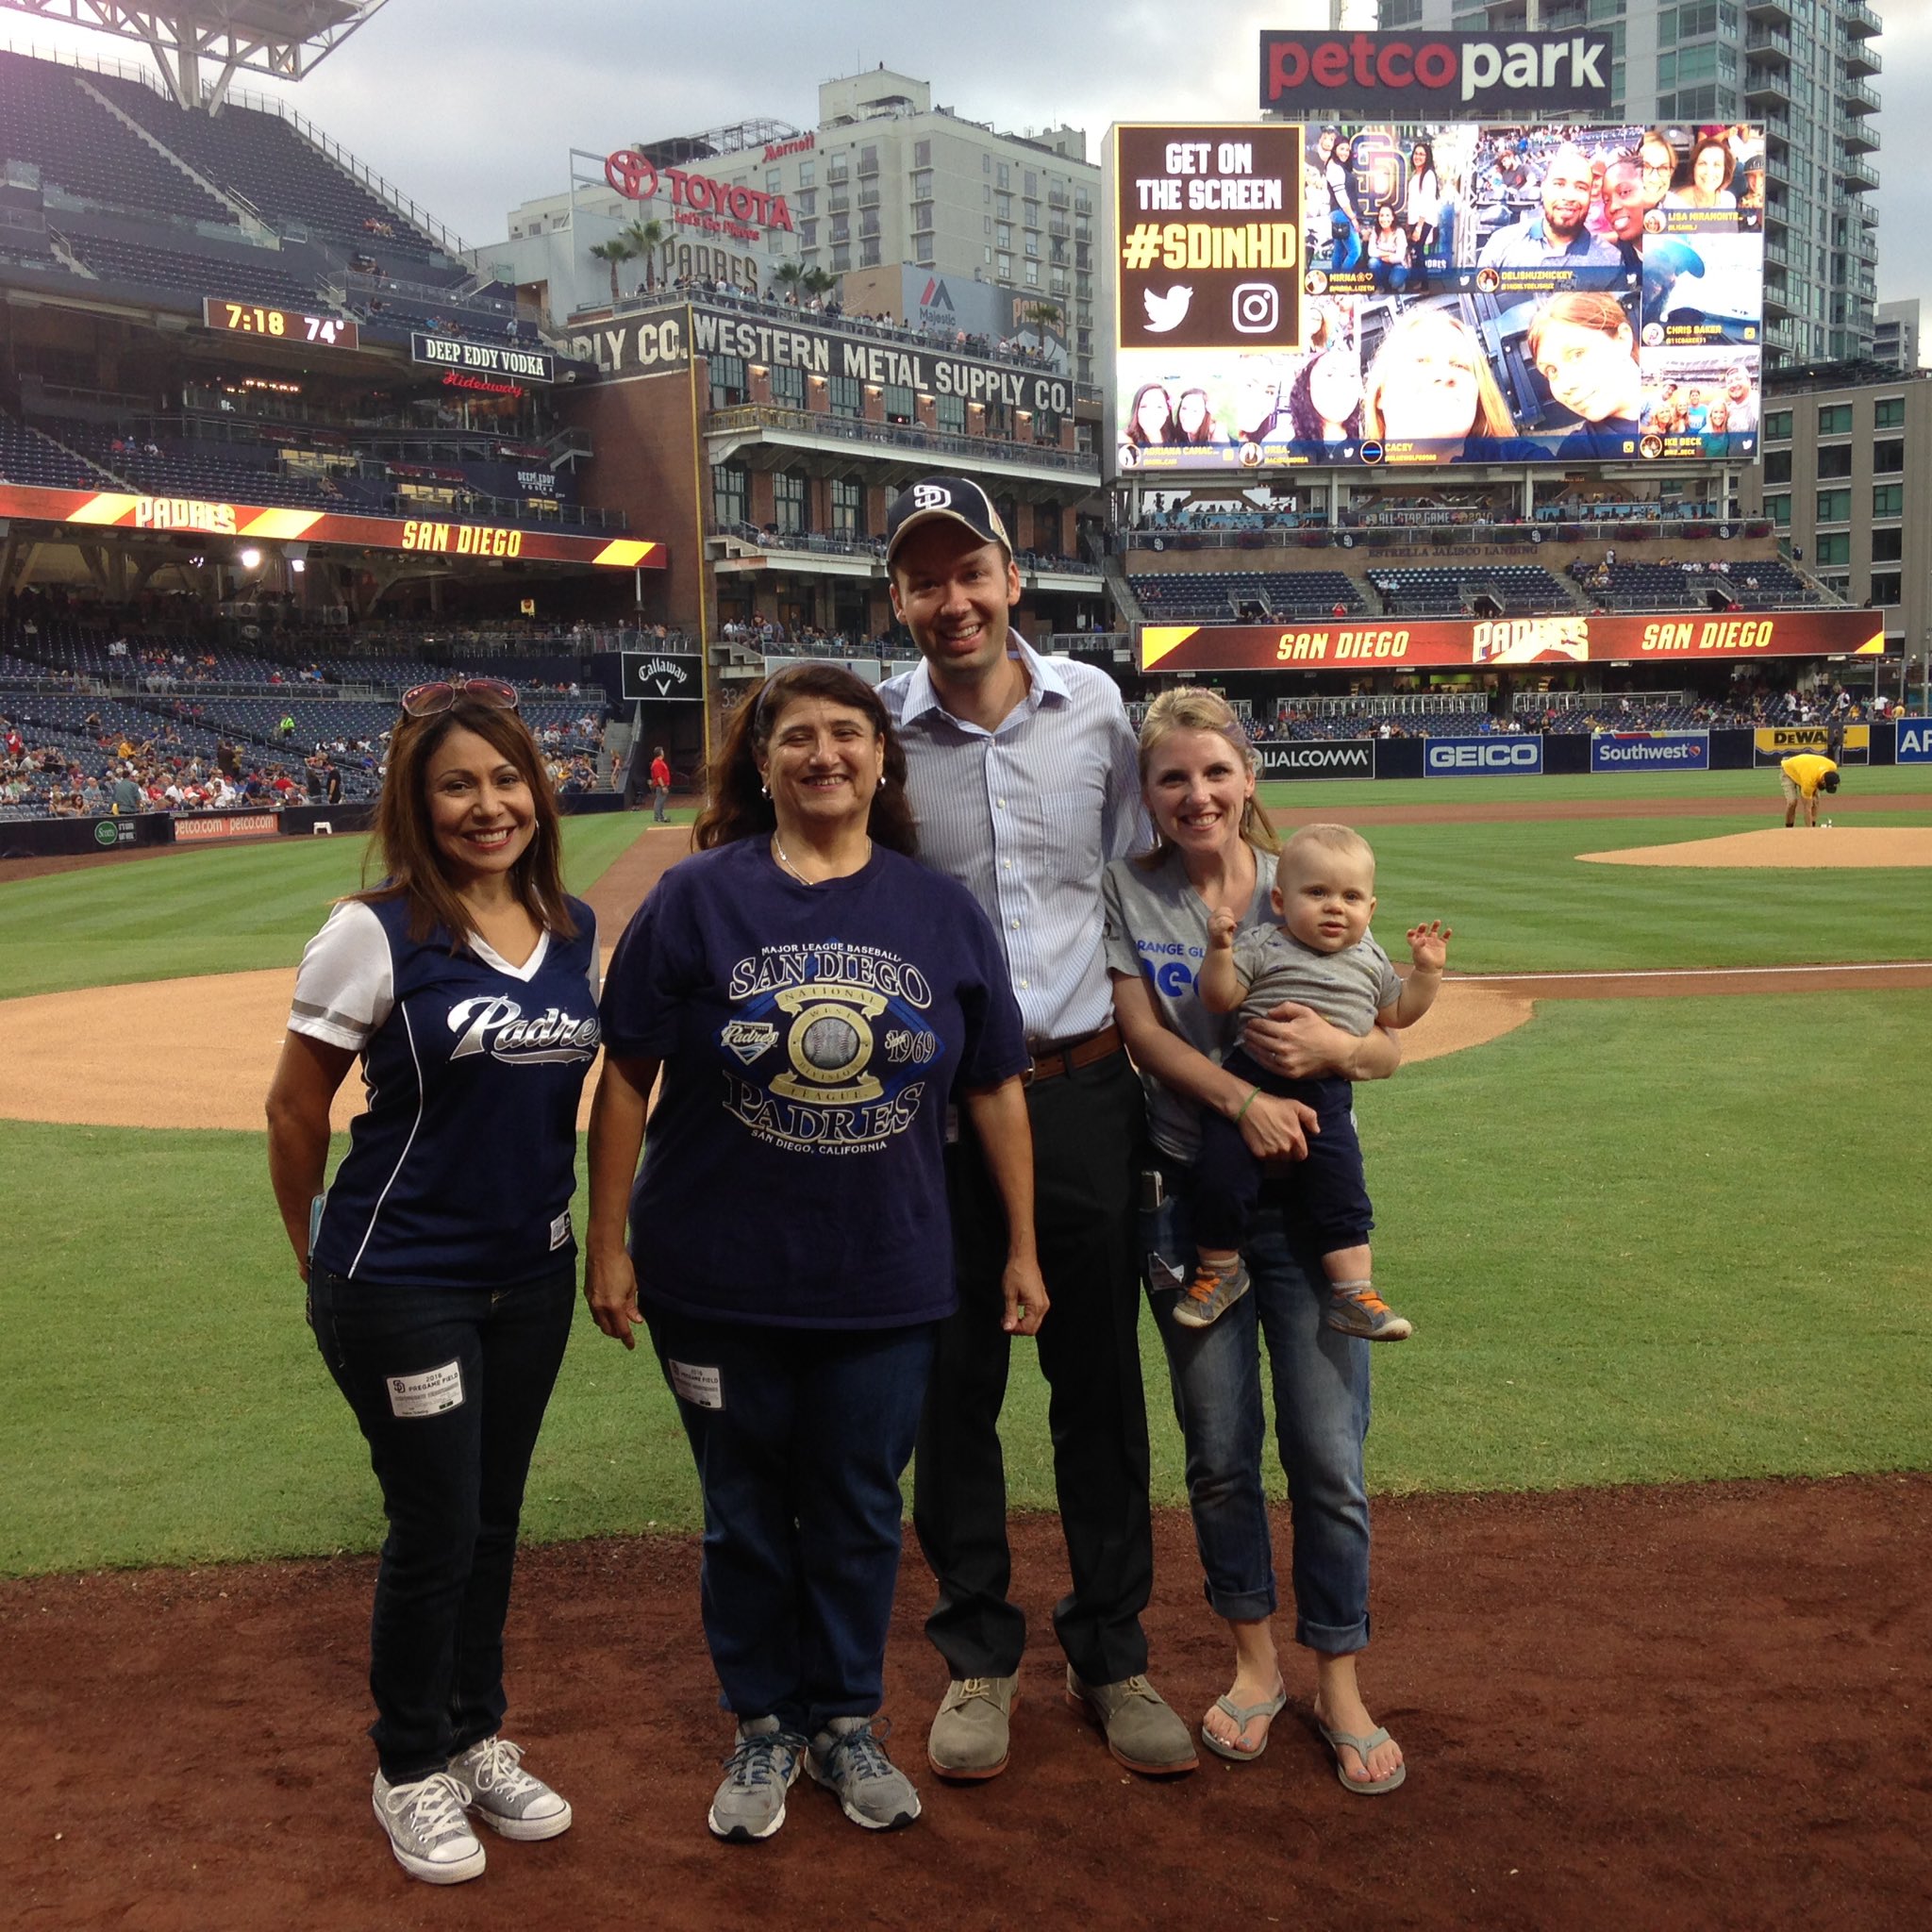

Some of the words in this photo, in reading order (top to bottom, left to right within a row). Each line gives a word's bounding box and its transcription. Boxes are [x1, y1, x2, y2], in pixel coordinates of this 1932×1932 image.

[762, 134, 816, 163] Marriott
[1166, 143, 1211, 175] GET
[1218, 143, 1253, 175] ON
[664, 167, 794, 232] TOYOTA
[1136, 179, 1182, 209] THE
[1189, 179, 1282, 209] SCREEN
[1329, 273, 1357, 282] MIRNA
[225, 305, 284, 336] 7:18
[920, 307, 956, 327] Majestic
[1666, 325, 1691, 334] CHRIS
[1693, 325, 1722, 334] BAKER
[638, 320, 689, 365] CO.
[425, 339, 461, 363] DEEP
[462, 345, 499, 369] EDDY
[500, 351, 545, 376] VODKA
[693, 312, 830, 374] WESTERN
[843, 343, 928, 391] METAL
[935, 361, 1025, 407] SUPPLY
[1035, 380, 1072, 413] CO.
[442, 372, 523, 397] Hideaway
[1385, 443, 1413, 452] CACEY
[1664, 438, 1677, 446] IKE
[517, 471, 535, 482] DEEP
[538, 474, 555, 485] EDDY
[136, 496, 238, 535] PADRES
[401, 521, 448, 551] SAN
[456, 525, 522, 558] DIEGO
[1368, 548, 1429, 558] ESTRELLA
[1432, 546, 1481, 557] JALISCO
[1485, 545, 1539, 555] LANDING
[1276, 633, 1329, 660] SAN
[1334, 631, 1409, 658] DIEGO
[1641, 623, 1694, 651] SAN
[1698, 621, 1774, 649] DIEGO
[638, 657, 688, 684] Callaway
[1429, 743, 1538, 768] GEICO
[1600, 743, 1688, 761] Southwest
[229, 814, 274, 835] petco.com
[761, 944, 799, 956] MAJOR
[802, 943, 844, 952] LEAGUE
[847, 944, 900, 962] BASEBALL
[729, 952, 809, 1000] SAN
[814, 951, 932, 1009] DIEGO
[785, 989, 876, 1005] NATIONAL
[721, 1025, 779, 1046] Padres
[887, 1029, 936, 1063] 1969
[723, 1069, 925, 1144] PADRES
[751, 1130, 773, 1143] SAN
[818, 1141, 887, 1155] CALIFORNIA
[408, 1379, 441, 1391] PREGAME
[442, 1372, 458, 1383] FIELD
